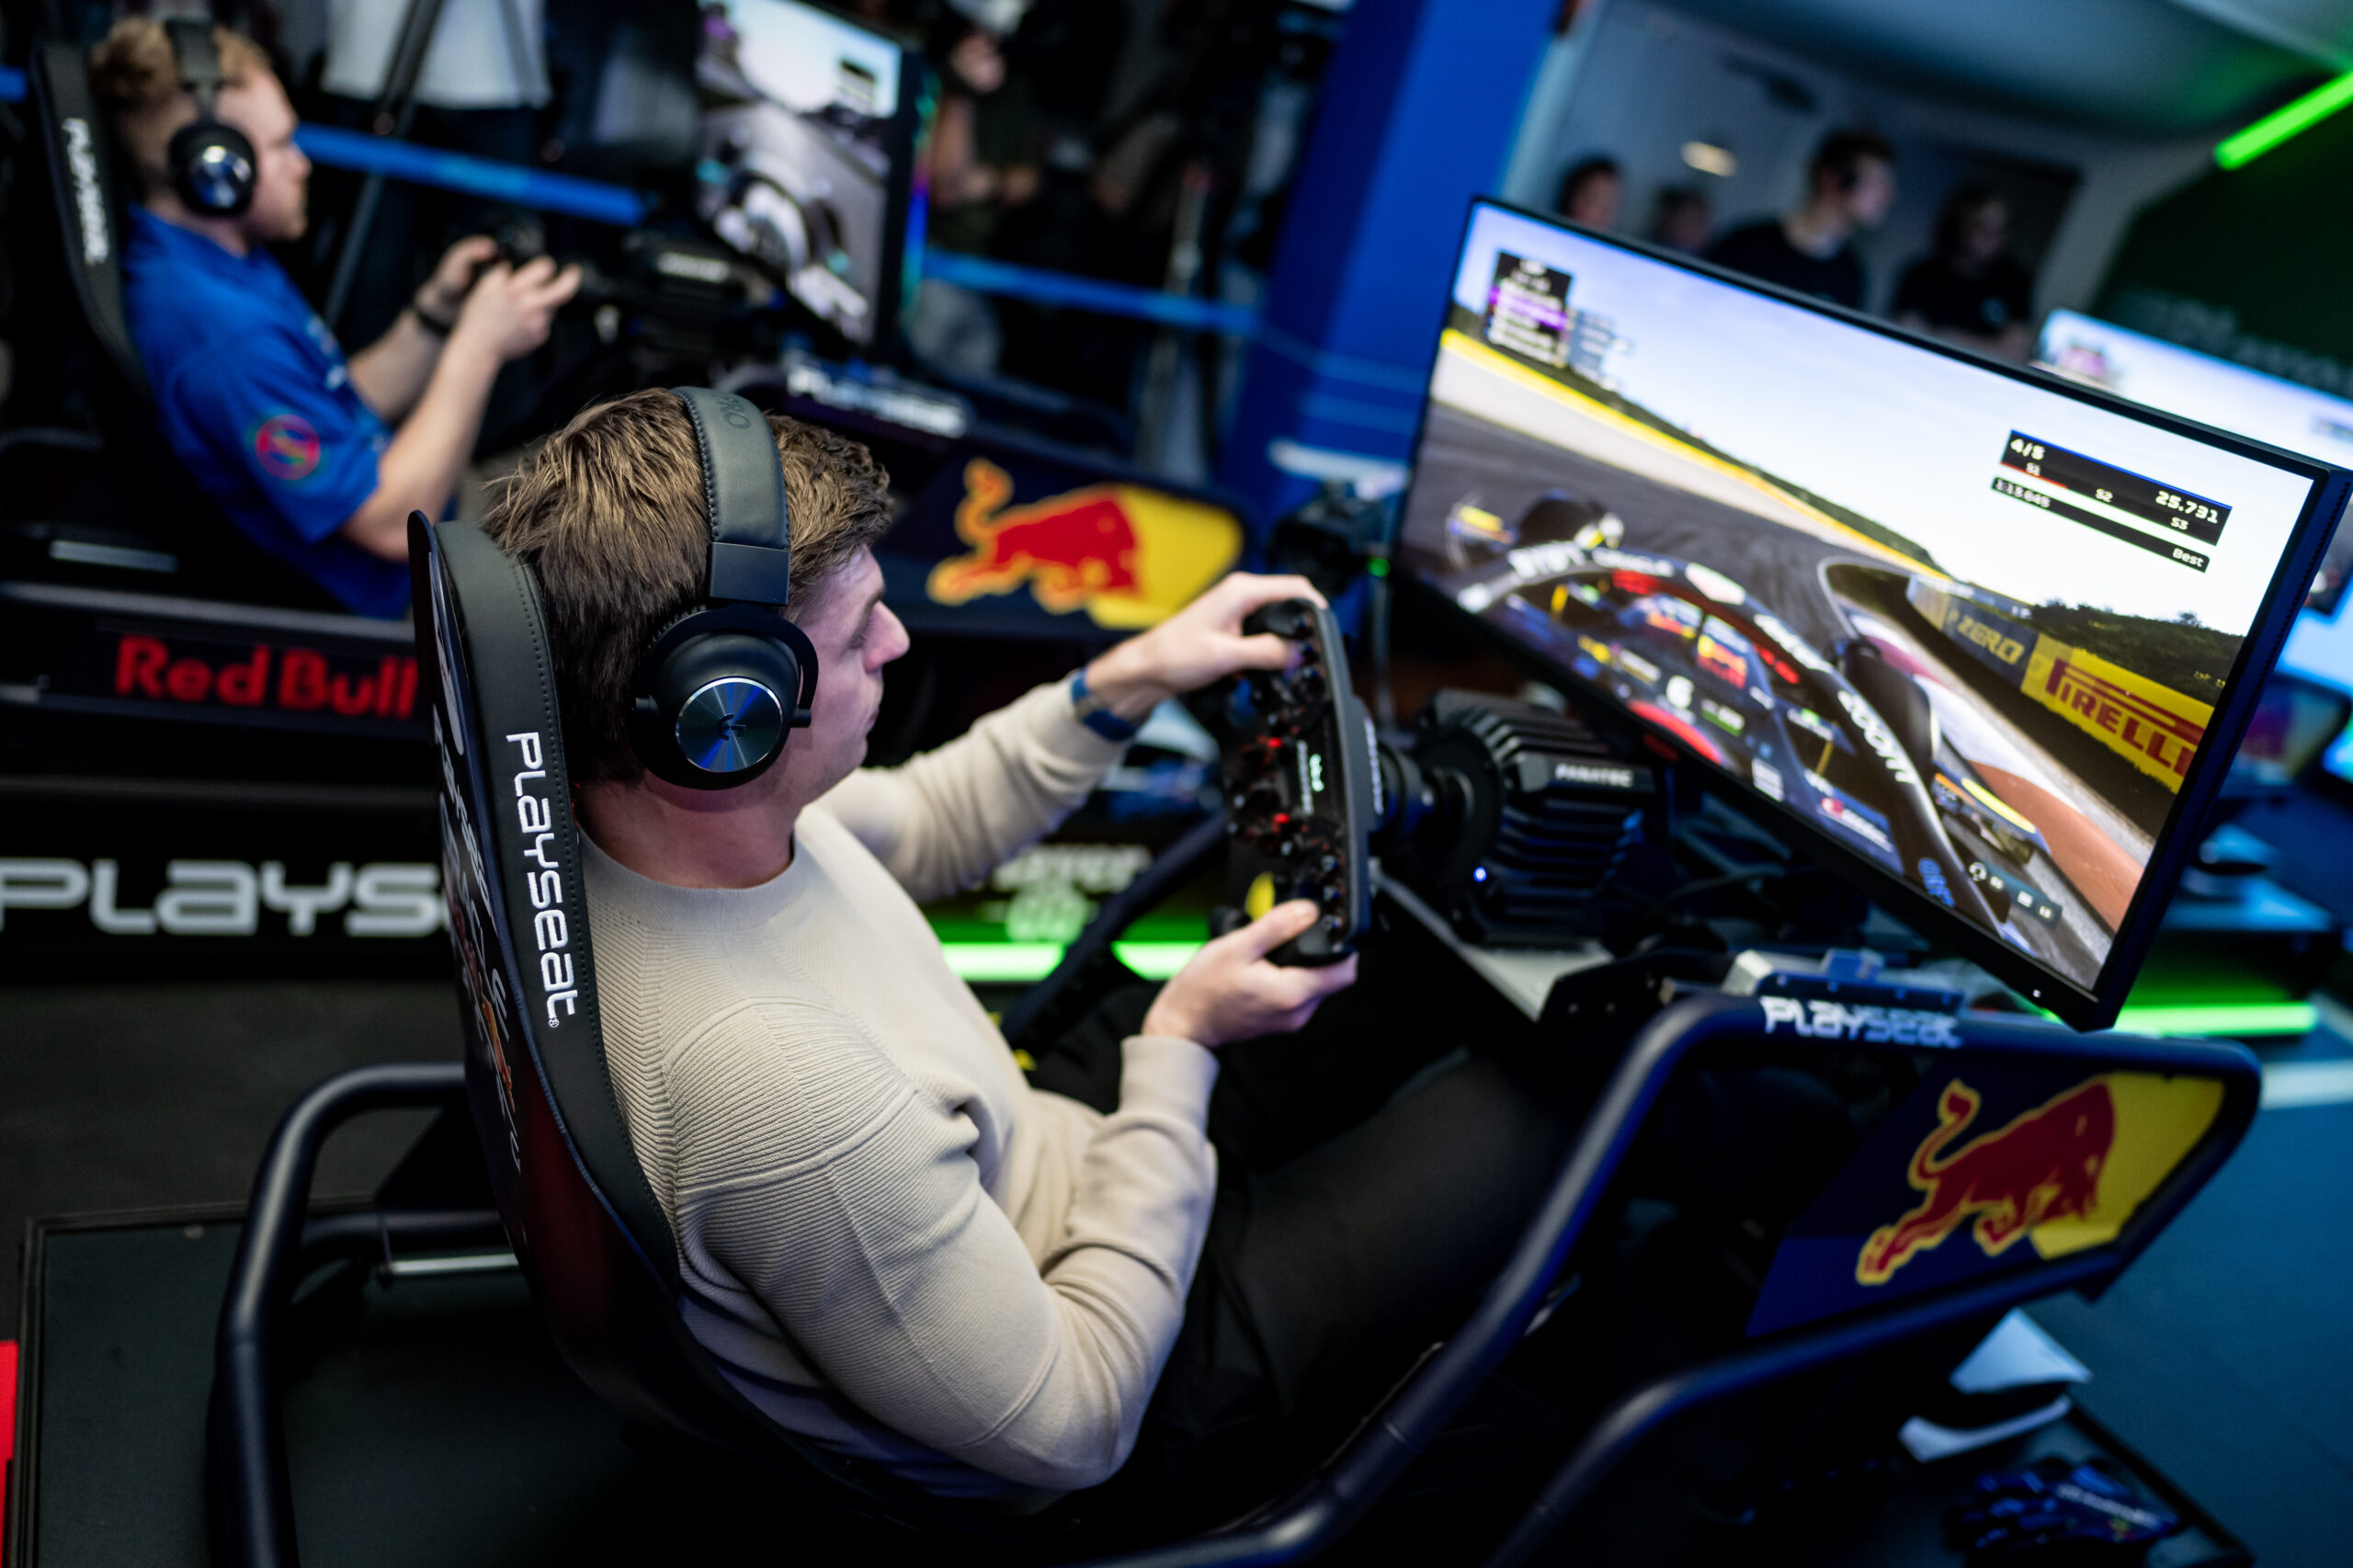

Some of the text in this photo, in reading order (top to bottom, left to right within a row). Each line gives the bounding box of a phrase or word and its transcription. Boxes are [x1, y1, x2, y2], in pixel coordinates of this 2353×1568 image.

[2010, 438, 2045, 460] 4/5
[2095, 487, 2113, 503] S2
[2155, 490, 2219, 524] 25.731
[2171, 517, 2189, 530] S3
[2173, 548, 2204, 567] Best
[1958, 613, 2025, 666] ZERO
[114, 635, 420, 721] Red Bull
